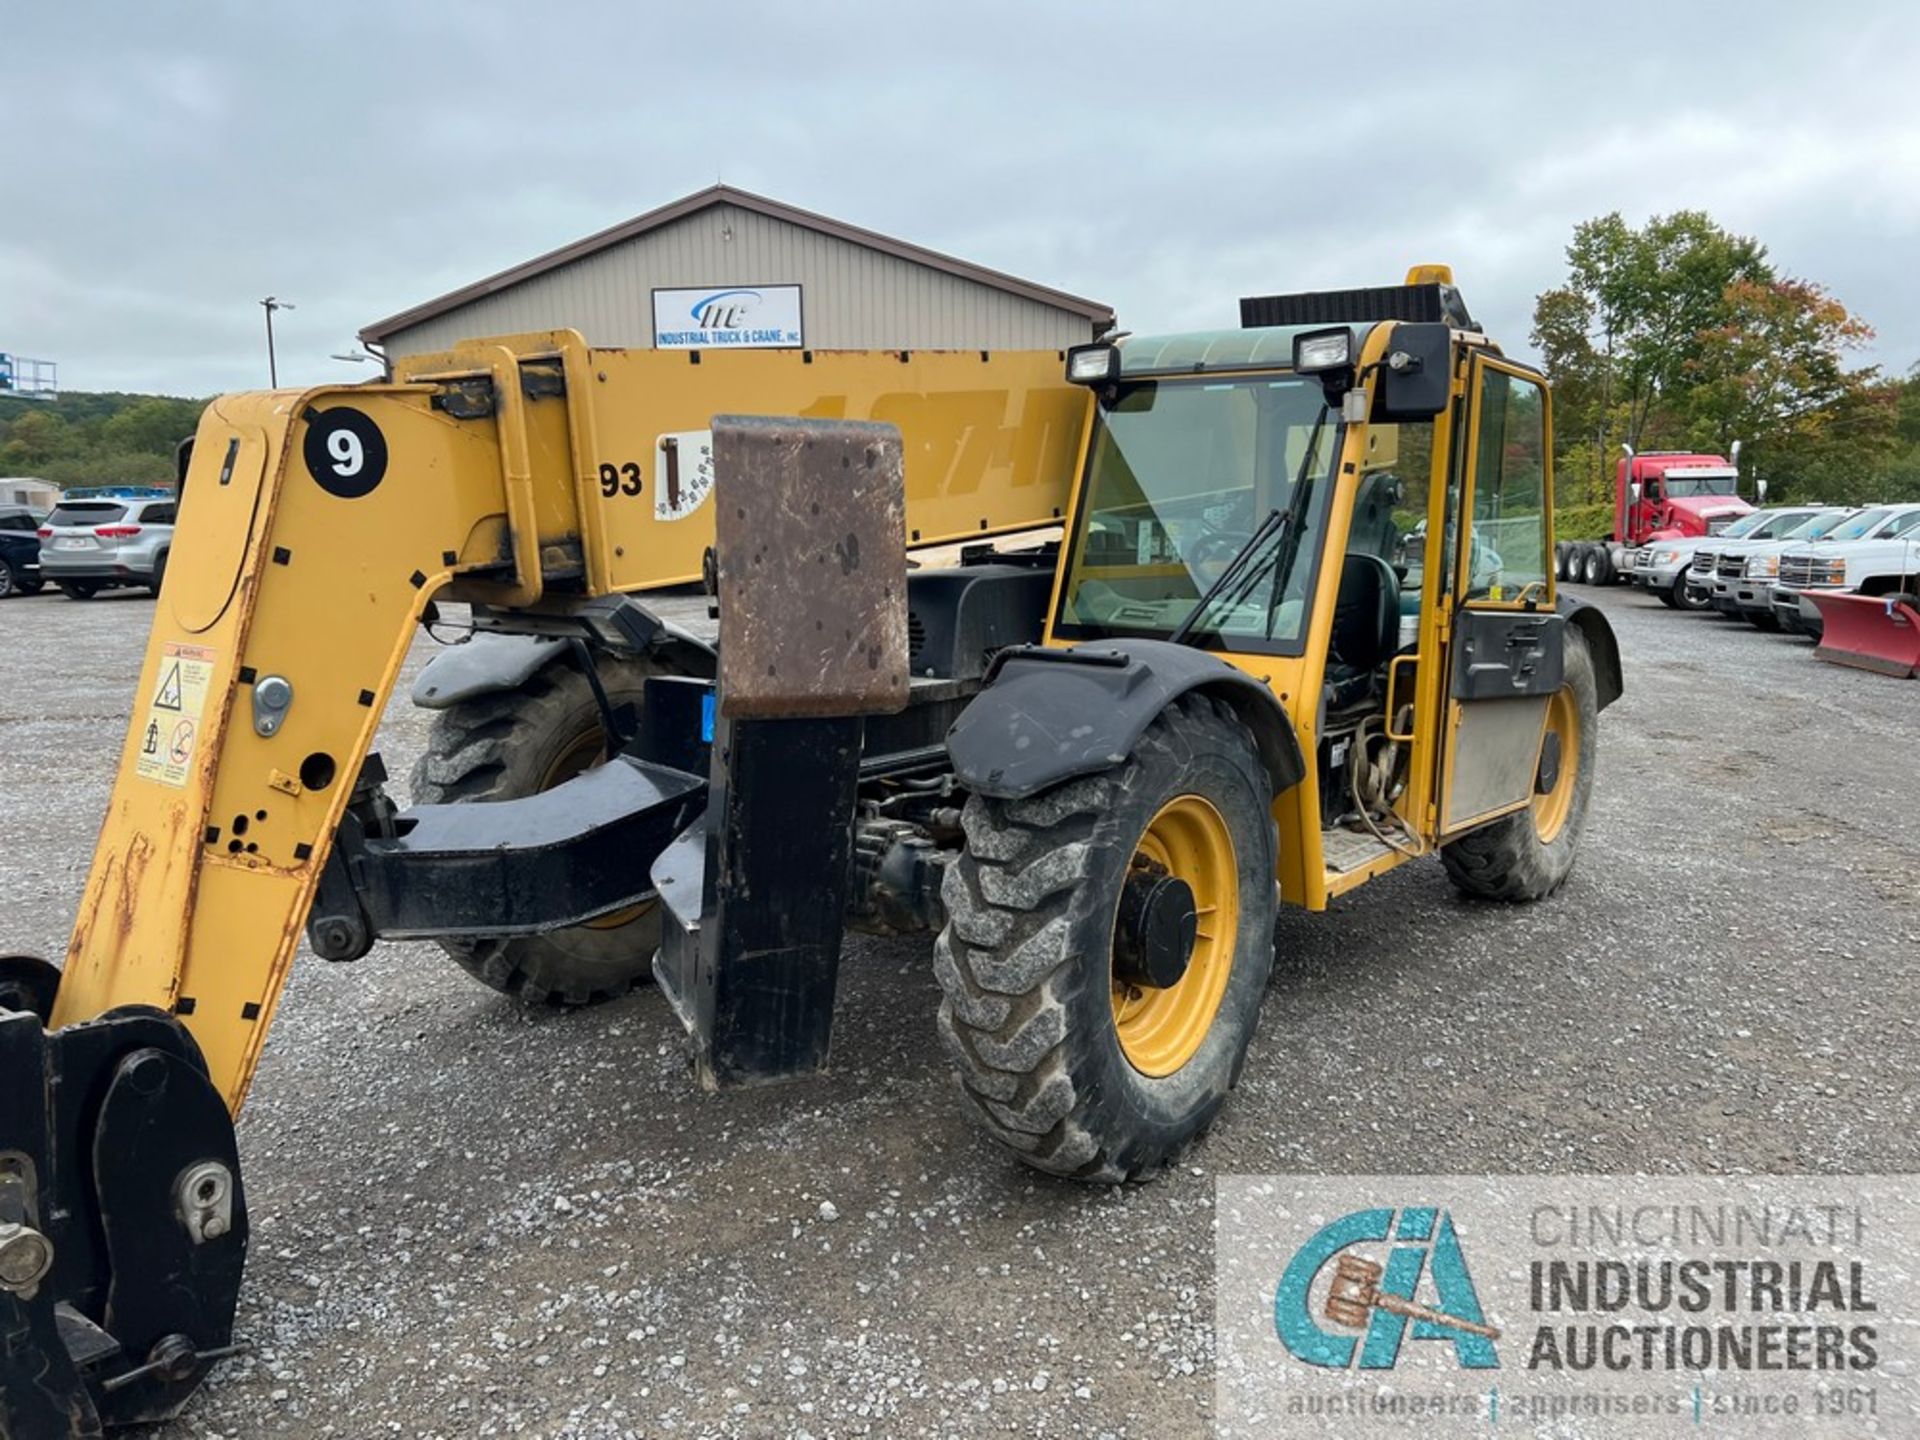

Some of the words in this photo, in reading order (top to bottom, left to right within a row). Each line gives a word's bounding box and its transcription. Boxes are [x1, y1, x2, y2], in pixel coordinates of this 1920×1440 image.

[658, 331, 710, 345] INDUSTRIAL
[712, 330, 741, 343] TRUCK
[743, 330, 750, 342] &
[327, 429, 364, 476] 9
[599, 462, 642, 498] 93
